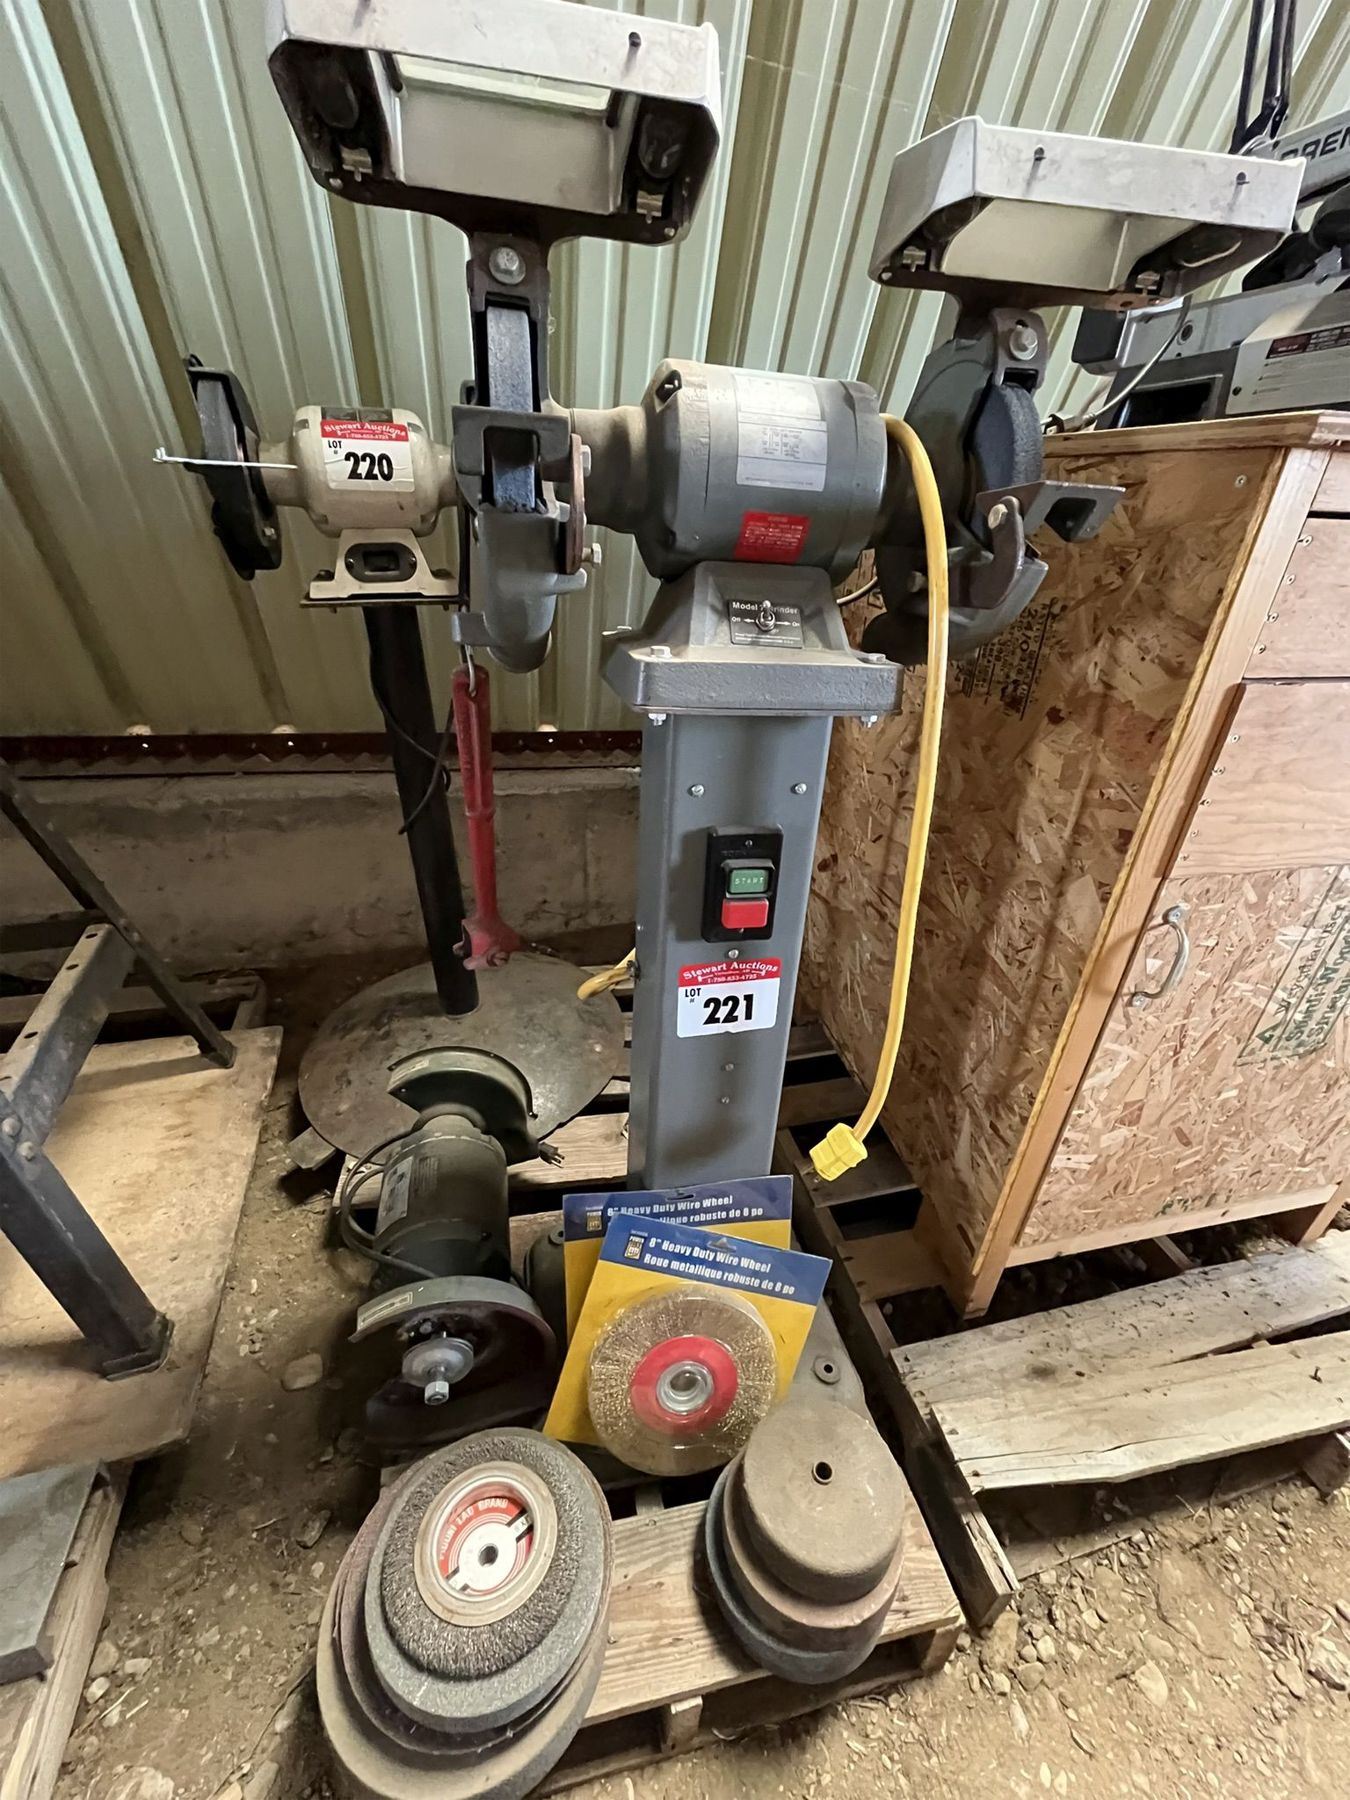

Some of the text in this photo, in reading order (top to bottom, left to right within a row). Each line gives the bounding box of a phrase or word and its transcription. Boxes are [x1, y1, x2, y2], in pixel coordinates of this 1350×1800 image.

[323, 422, 407, 436] Stewart Auctions
[328, 440, 342, 449] LOT
[344, 451, 394, 482] 220
[732, 601, 758, 611] Model
[734, 877, 764, 885] START
[683, 963, 727, 980] Stewart
[730, 961, 779, 973] Auctions
[684, 987, 702, 998] LOT
[702, 993, 754, 1026] 221
[620, 1205, 651, 1215] Heavy
[652, 1203, 676, 1214] Duty
[677, 1201, 701, 1211] Wire
[702, 1194, 733, 1208] Wheel
[690, 1210, 727, 1223] robuste
[728, 1208, 741, 1218] de
[743, 1207, 750, 1217] 8
[751, 1207, 764, 1217] po
[649, 1237, 662, 1248] 8"
[662, 1240, 692, 1257] Heavy
[692, 1246, 716, 1262] Duty
[715, 1251, 739, 1266] Wire
[740, 1256, 772, 1273] Wheel
[643, 1253, 670, 1268] Roue
[723, 1271, 760, 1288] robuste
[761, 1279, 774, 1290] de
[774, 1281, 782, 1293] 8
[782, 1285, 795, 1295] po
